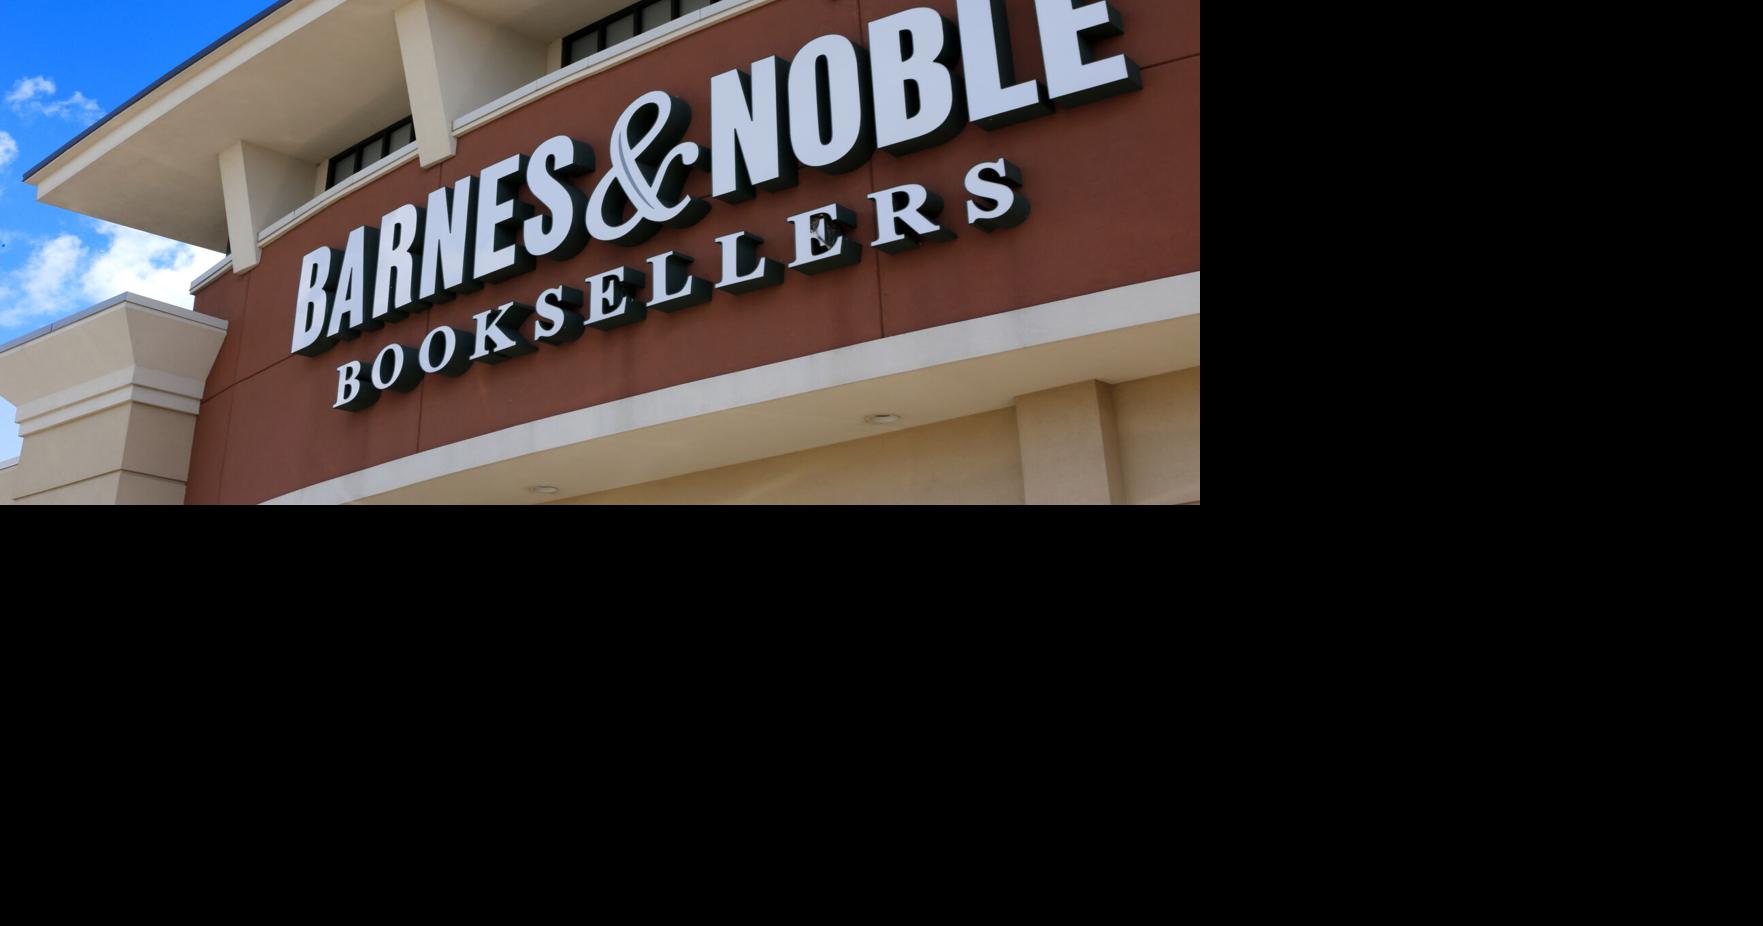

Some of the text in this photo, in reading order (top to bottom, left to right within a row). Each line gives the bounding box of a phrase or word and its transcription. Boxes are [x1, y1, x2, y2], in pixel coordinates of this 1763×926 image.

[290, 0, 1129, 355] BARNES & NOBLE
[332, 157, 1018, 410] BOOKSELLERS
